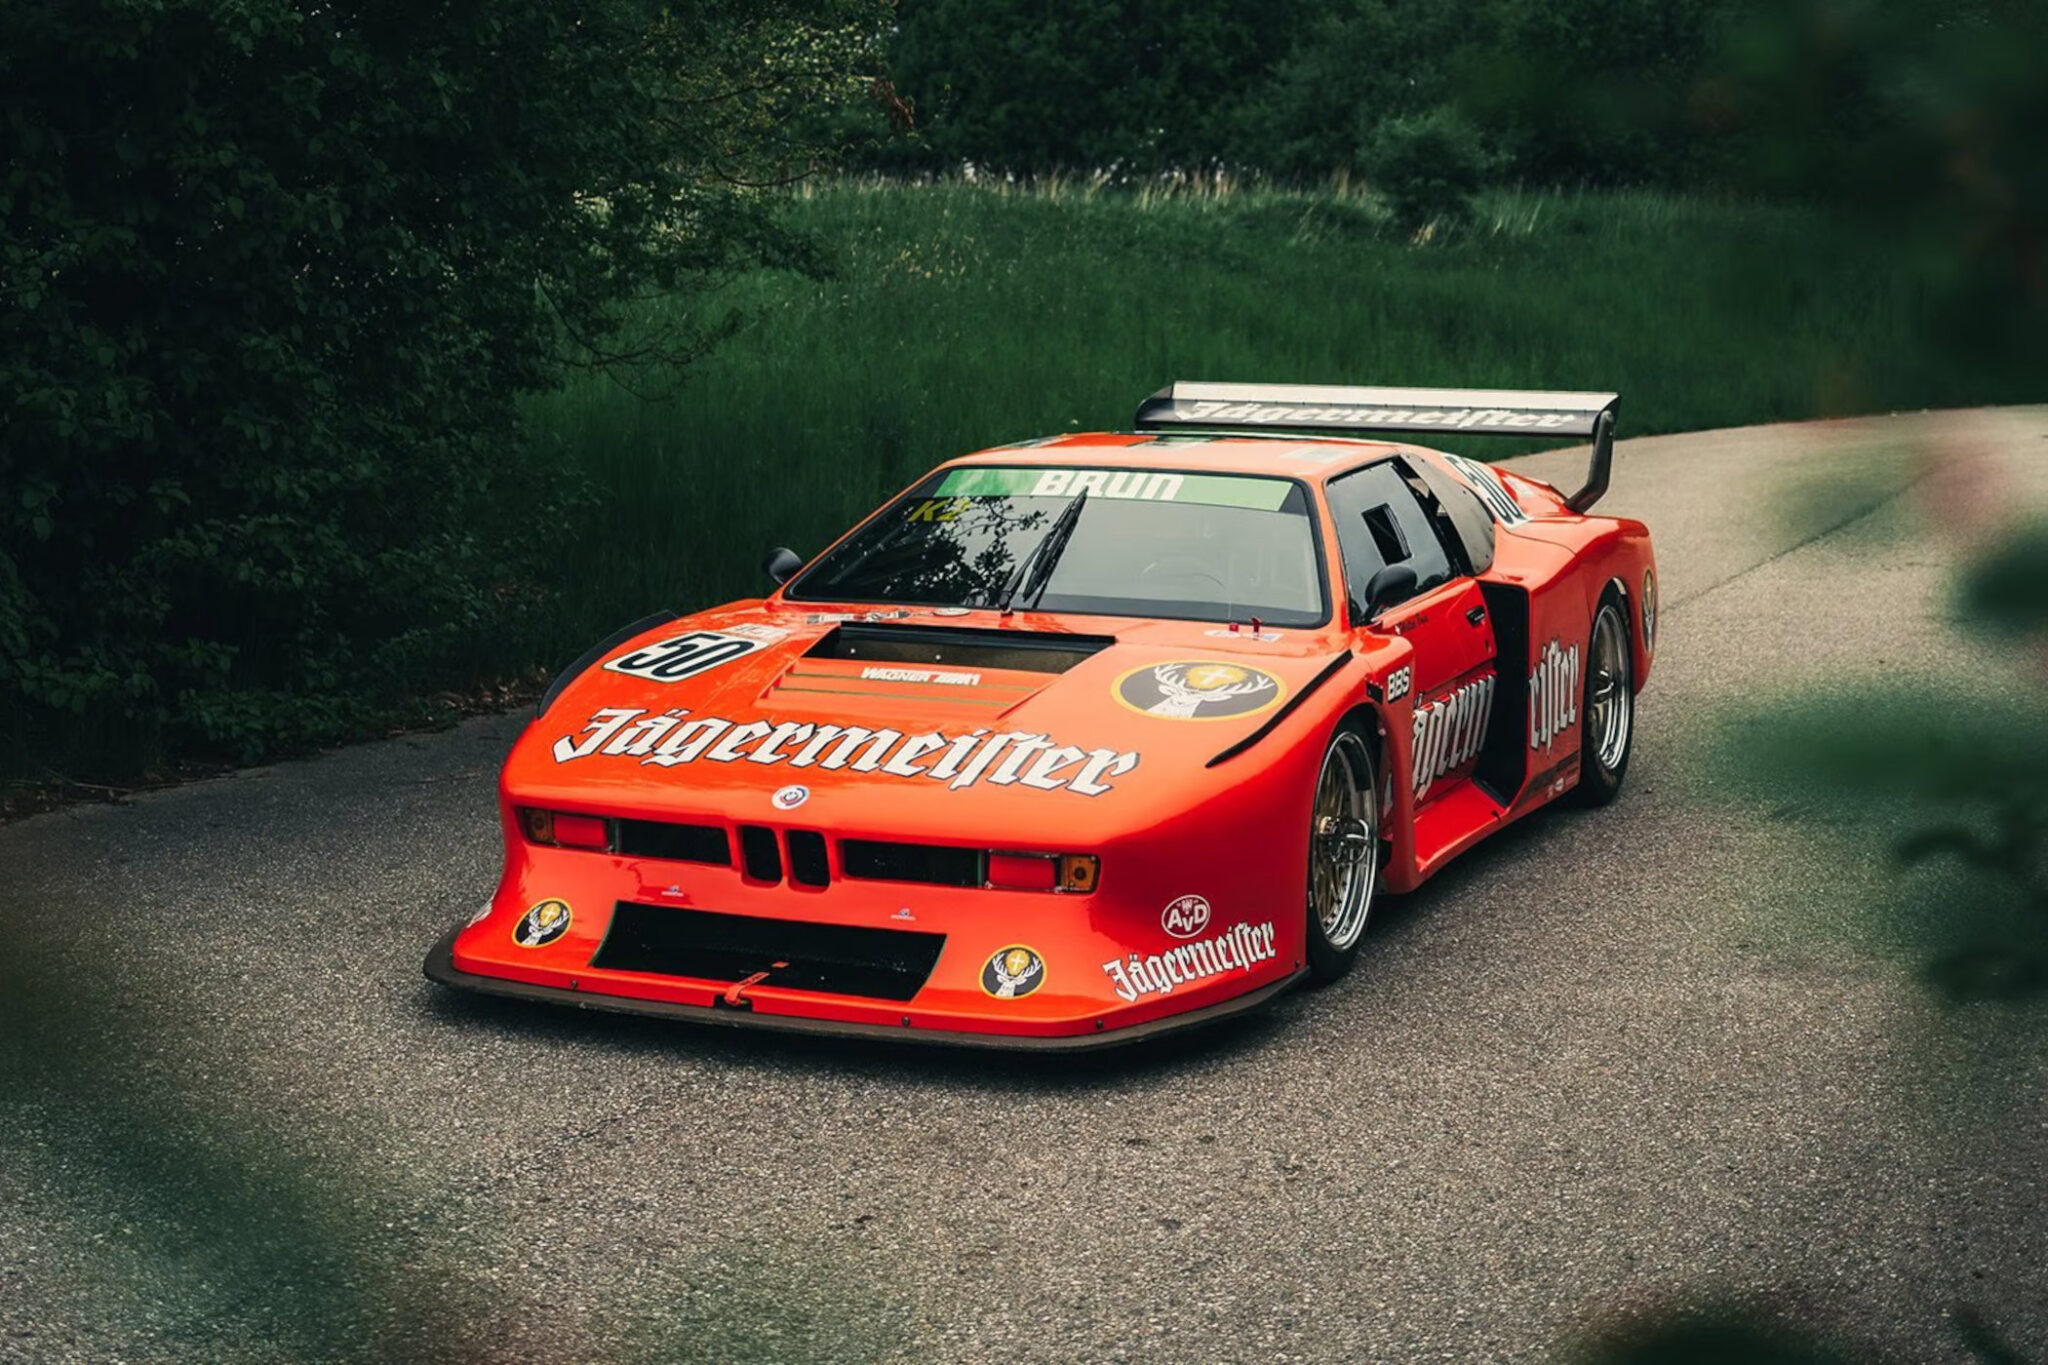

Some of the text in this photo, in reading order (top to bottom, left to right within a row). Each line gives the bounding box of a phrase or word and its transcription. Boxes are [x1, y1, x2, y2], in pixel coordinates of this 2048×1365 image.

[1029, 470, 1184, 500] BRUN
[617, 632, 756, 678] 50
[1387, 666, 1410, 701] BBS
